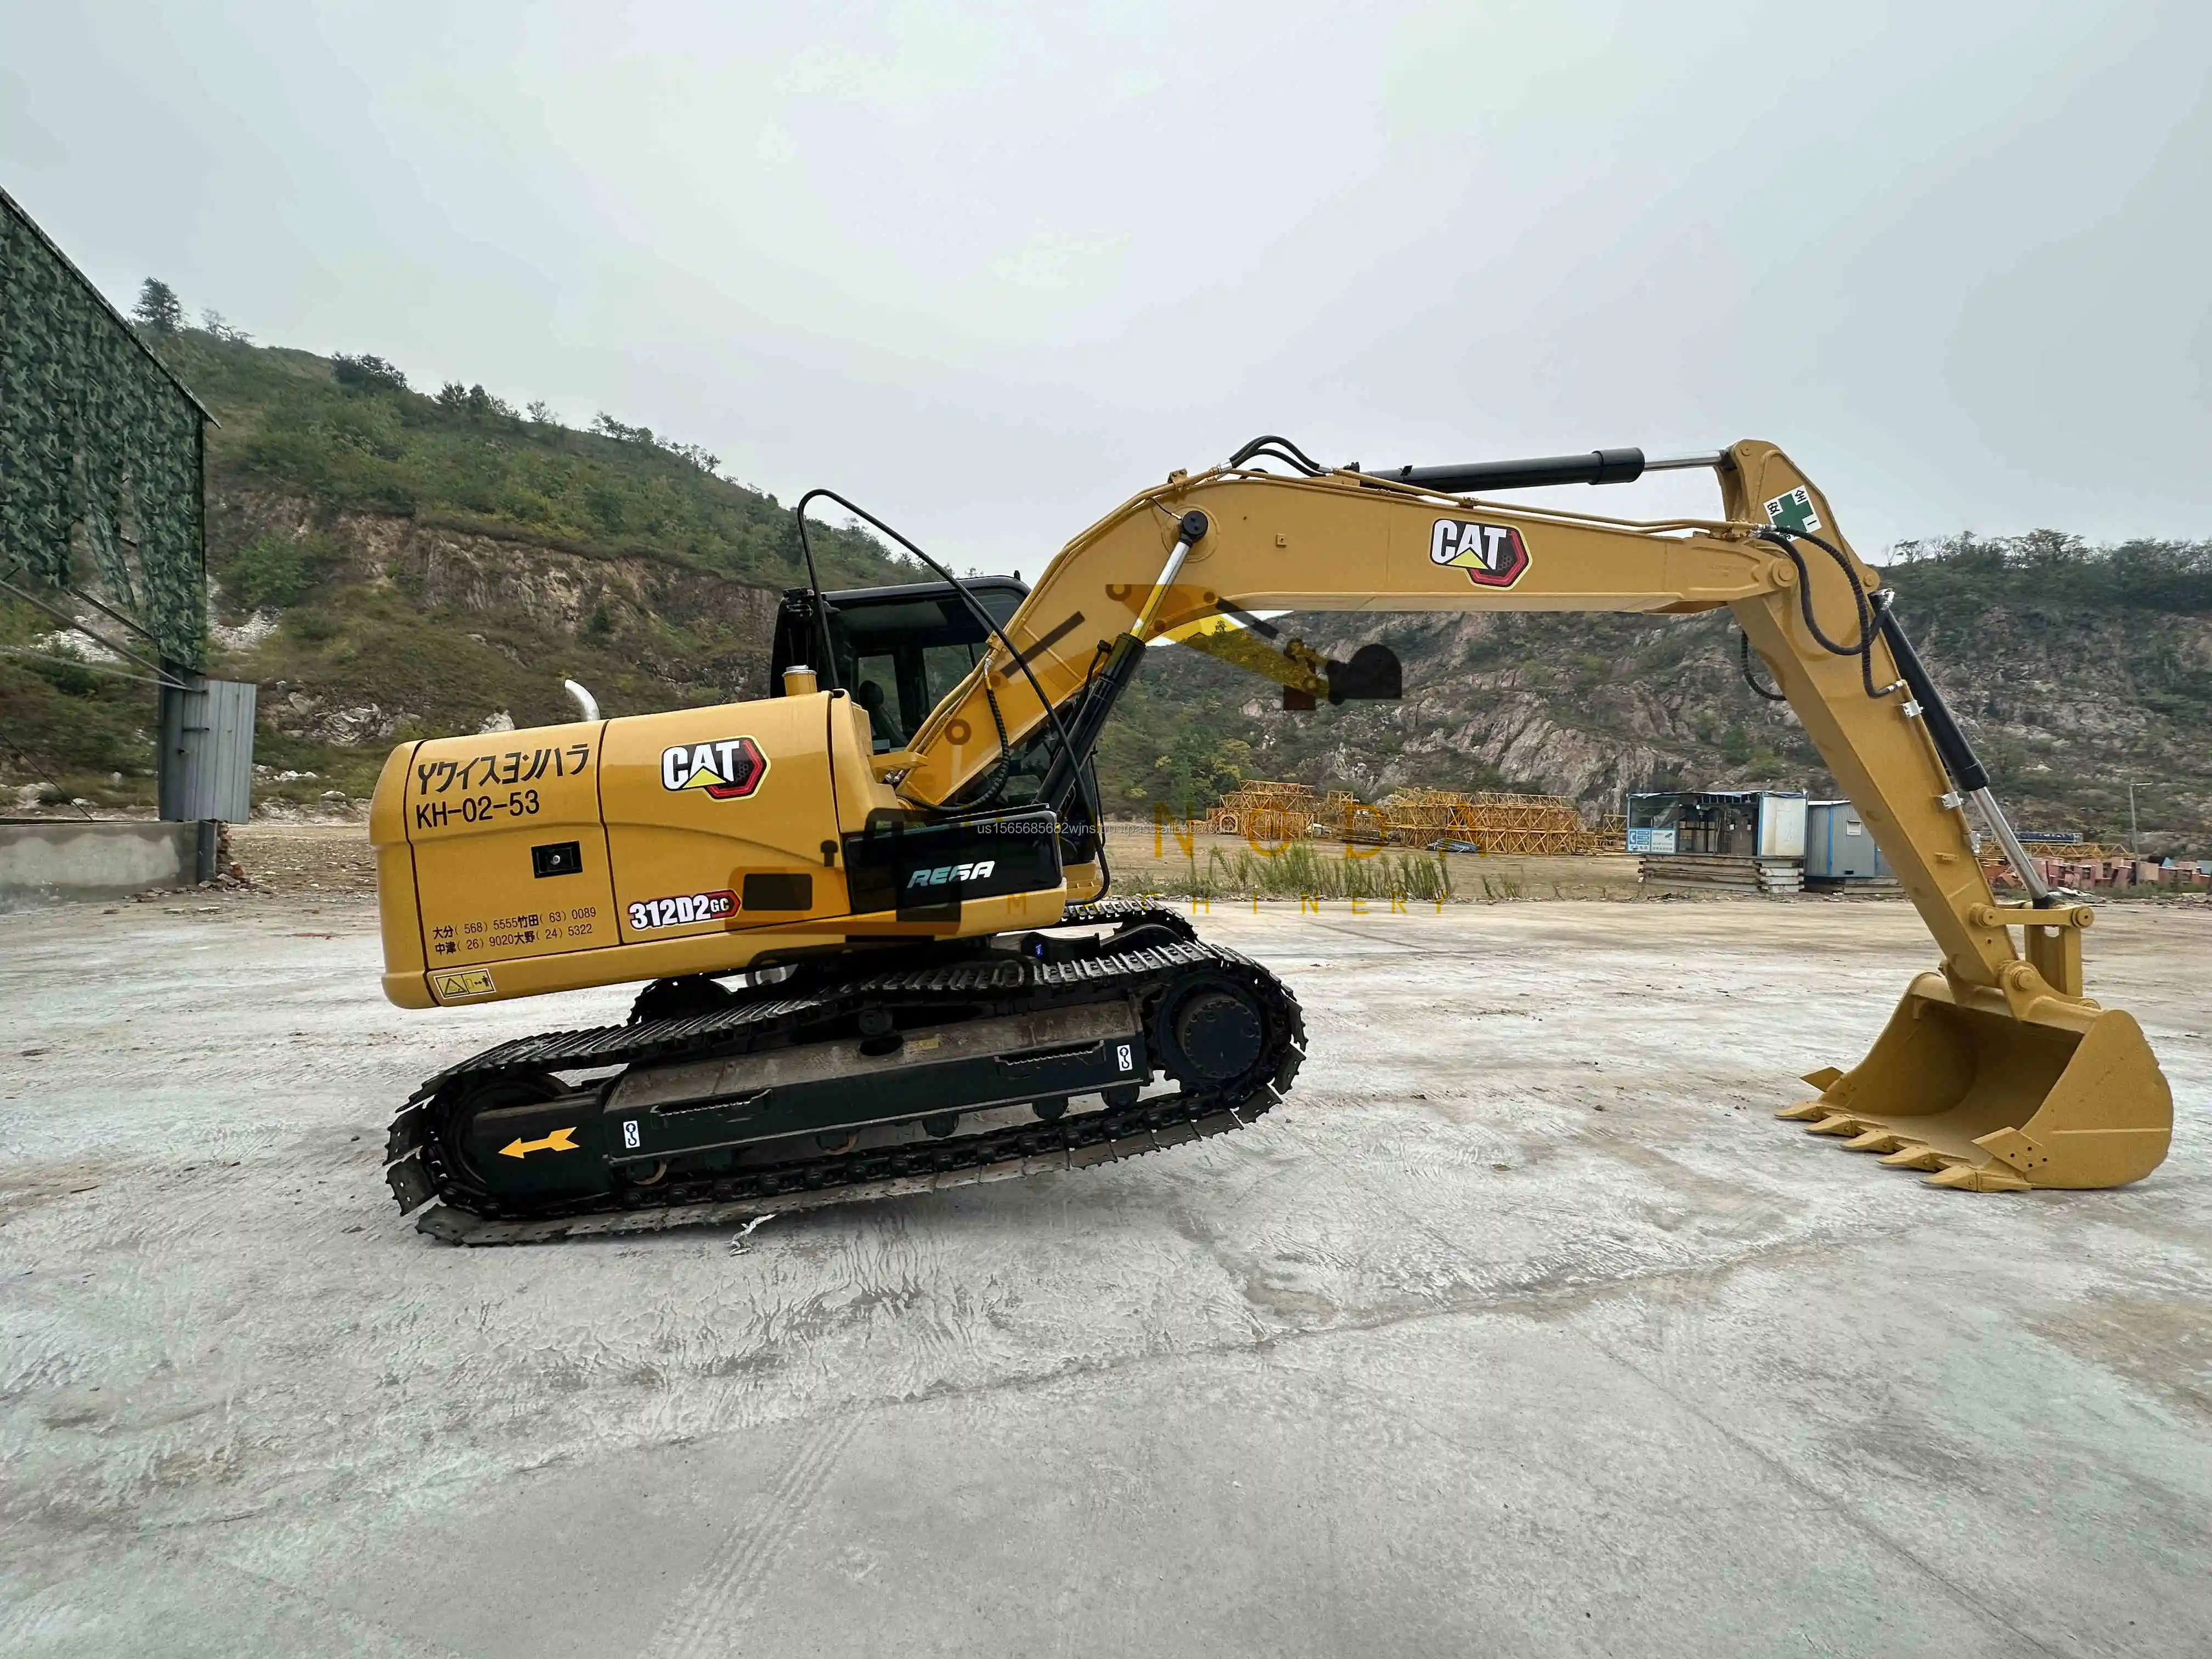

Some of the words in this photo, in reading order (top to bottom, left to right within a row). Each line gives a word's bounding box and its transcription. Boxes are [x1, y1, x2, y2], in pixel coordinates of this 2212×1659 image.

[1431, 520, 1507, 571] CAT
[663, 740, 740, 789] CAT
[416, 789, 540, 829] KH-02-53
[629, 894, 712, 929] 312D2
[709, 898, 730, 912] GC
